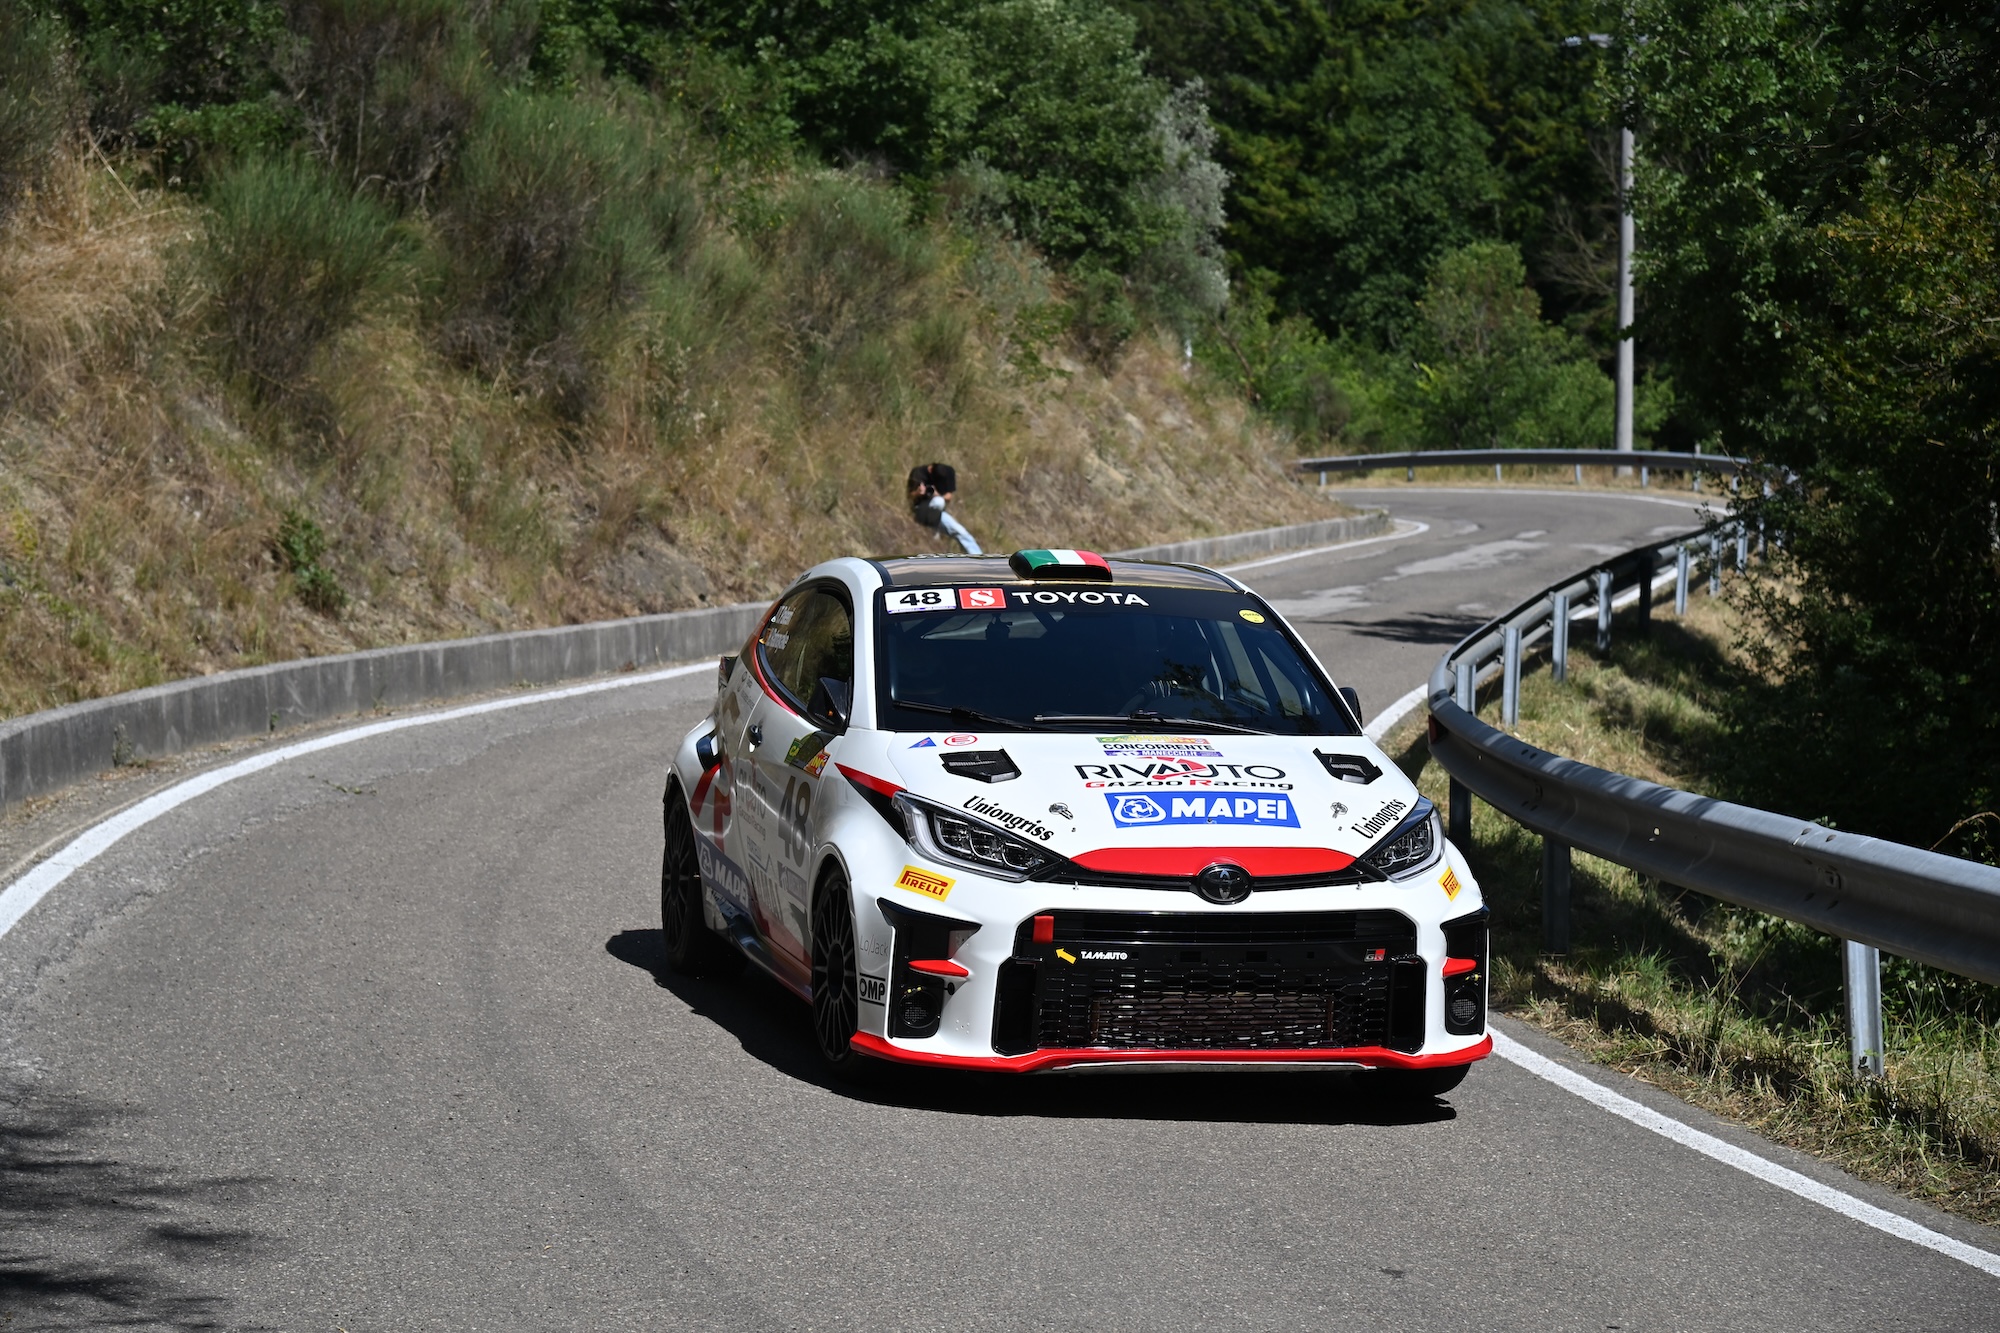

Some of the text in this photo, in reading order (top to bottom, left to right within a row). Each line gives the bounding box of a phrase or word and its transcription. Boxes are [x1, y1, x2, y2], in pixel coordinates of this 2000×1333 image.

[899, 591, 942, 606] 48
[1011, 591, 1150, 607] TOYOTA
[1103, 743, 1215, 751] CONCORRENTE
[1074, 763, 1286, 780] RIVAUTO
[1190, 779, 1294, 791] Racing
[962, 795, 1055, 841] Uniongriss
[1171, 797, 1288, 820] MAPEI
[1351, 799, 1407, 839] Uniongriss
[778, 775, 811, 868] 48
[714, 859, 750, 908] MAPEI
[900, 870, 949, 896] PIRELLI
[859, 977, 886, 1001] OMP
